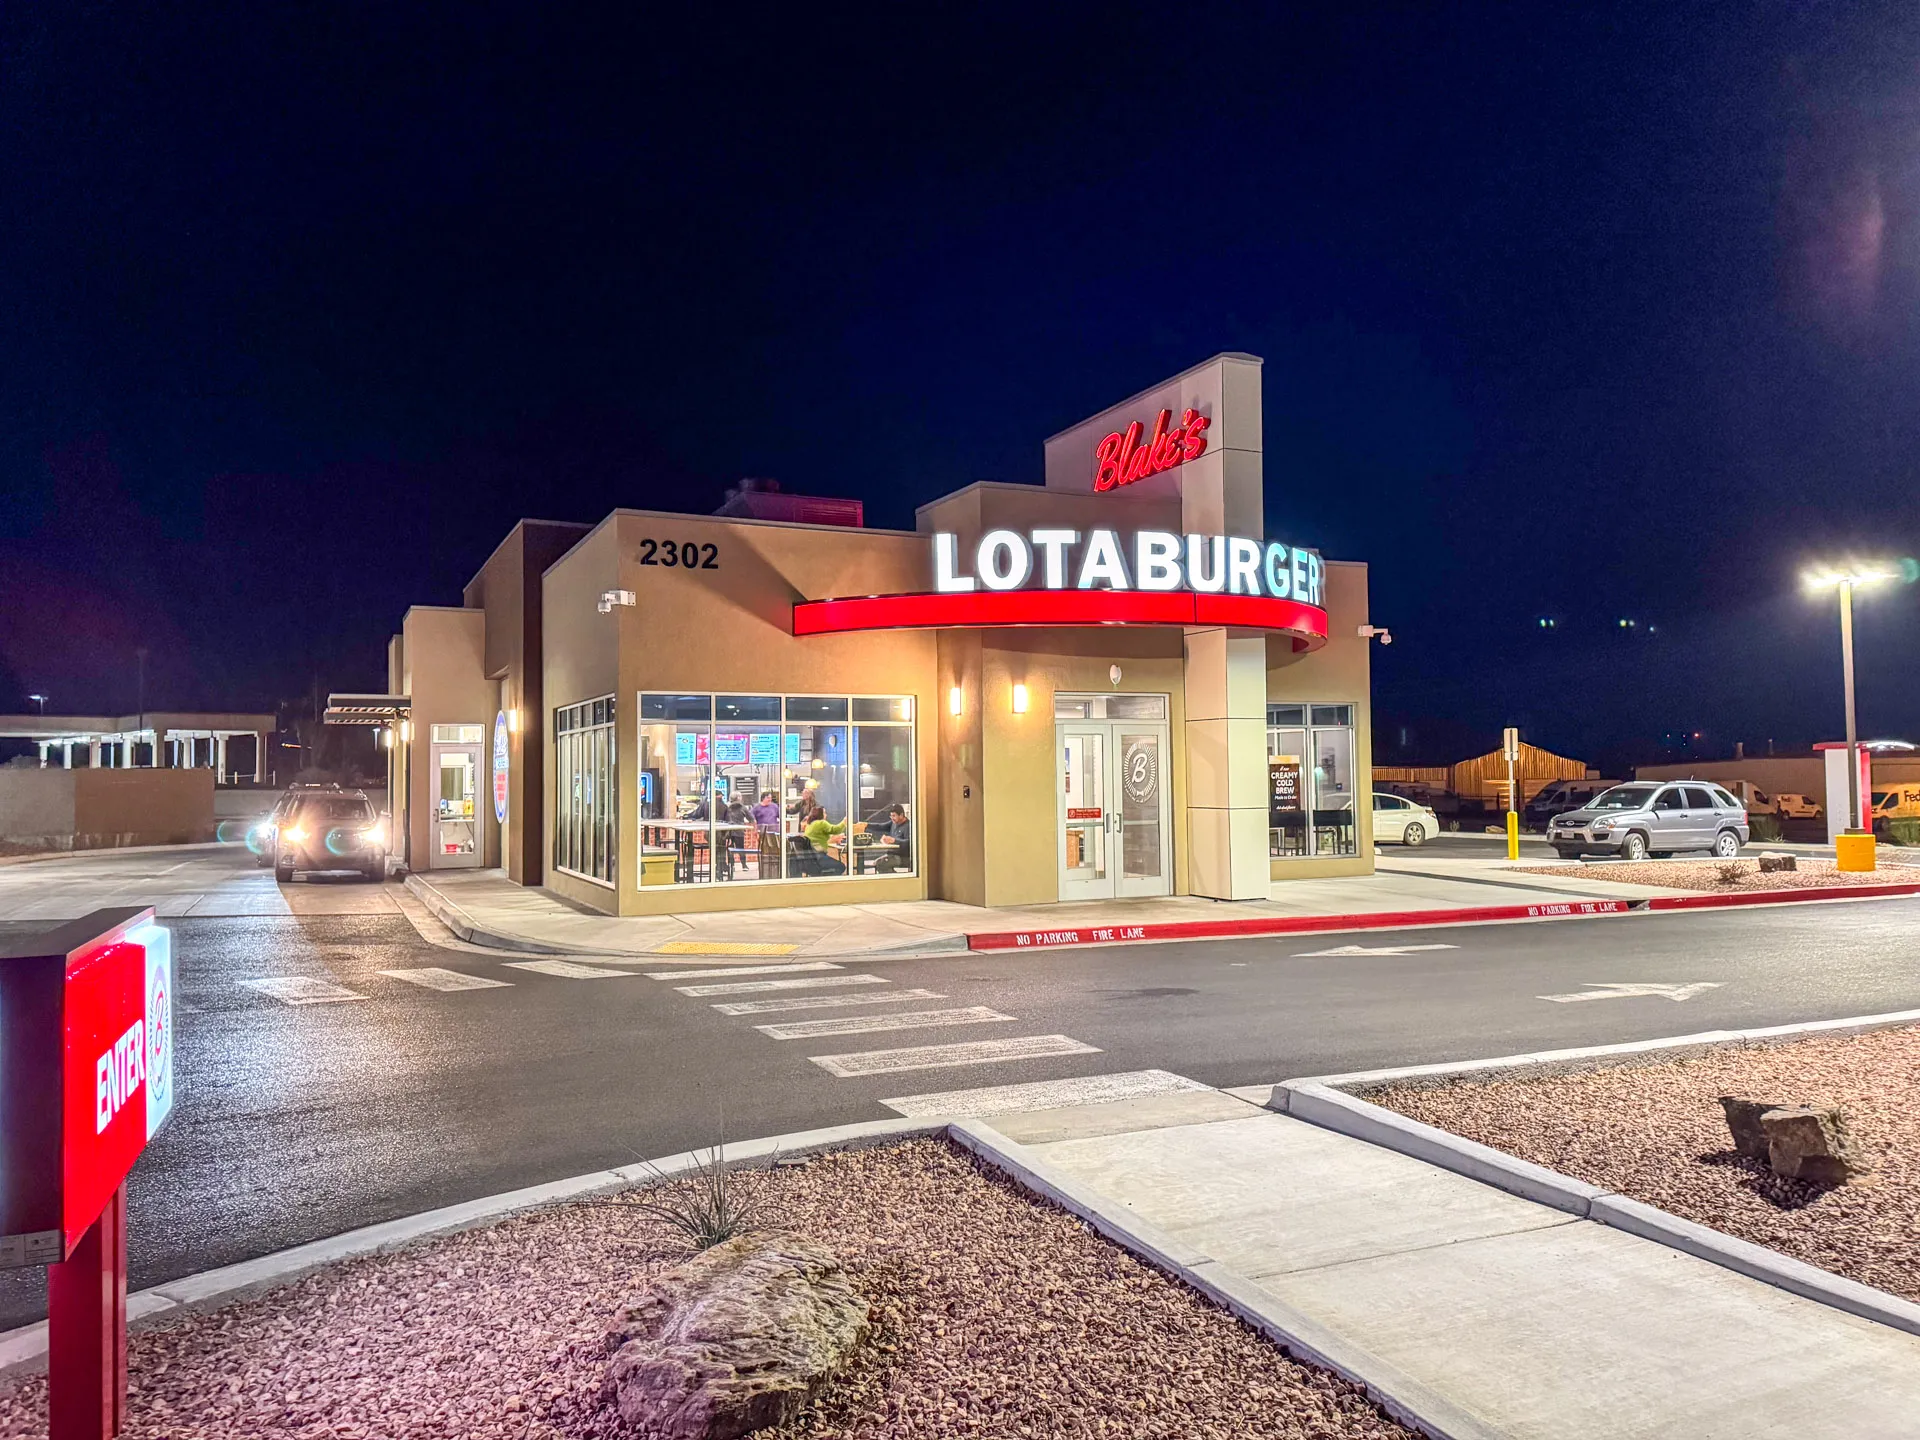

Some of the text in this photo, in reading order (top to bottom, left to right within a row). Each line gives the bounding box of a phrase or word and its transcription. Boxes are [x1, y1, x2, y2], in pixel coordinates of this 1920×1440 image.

[1094, 408, 1211, 492] Blake's
[640, 539, 718, 569] 2302
[935, 529, 1322, 606] LOTABURGER
[1271, 771, 1298, 779] CREAMY
[1276, 779, 1294, 787] COLD
[1275, 786, 1295, 795] BREW
[1527, 902, 1618, 917] NO PARKING FIRE LANE
[1016, 927, 1146, 946] NO PARKING FIRE LANE
[96, 1019, 146, 1135] ENTER
